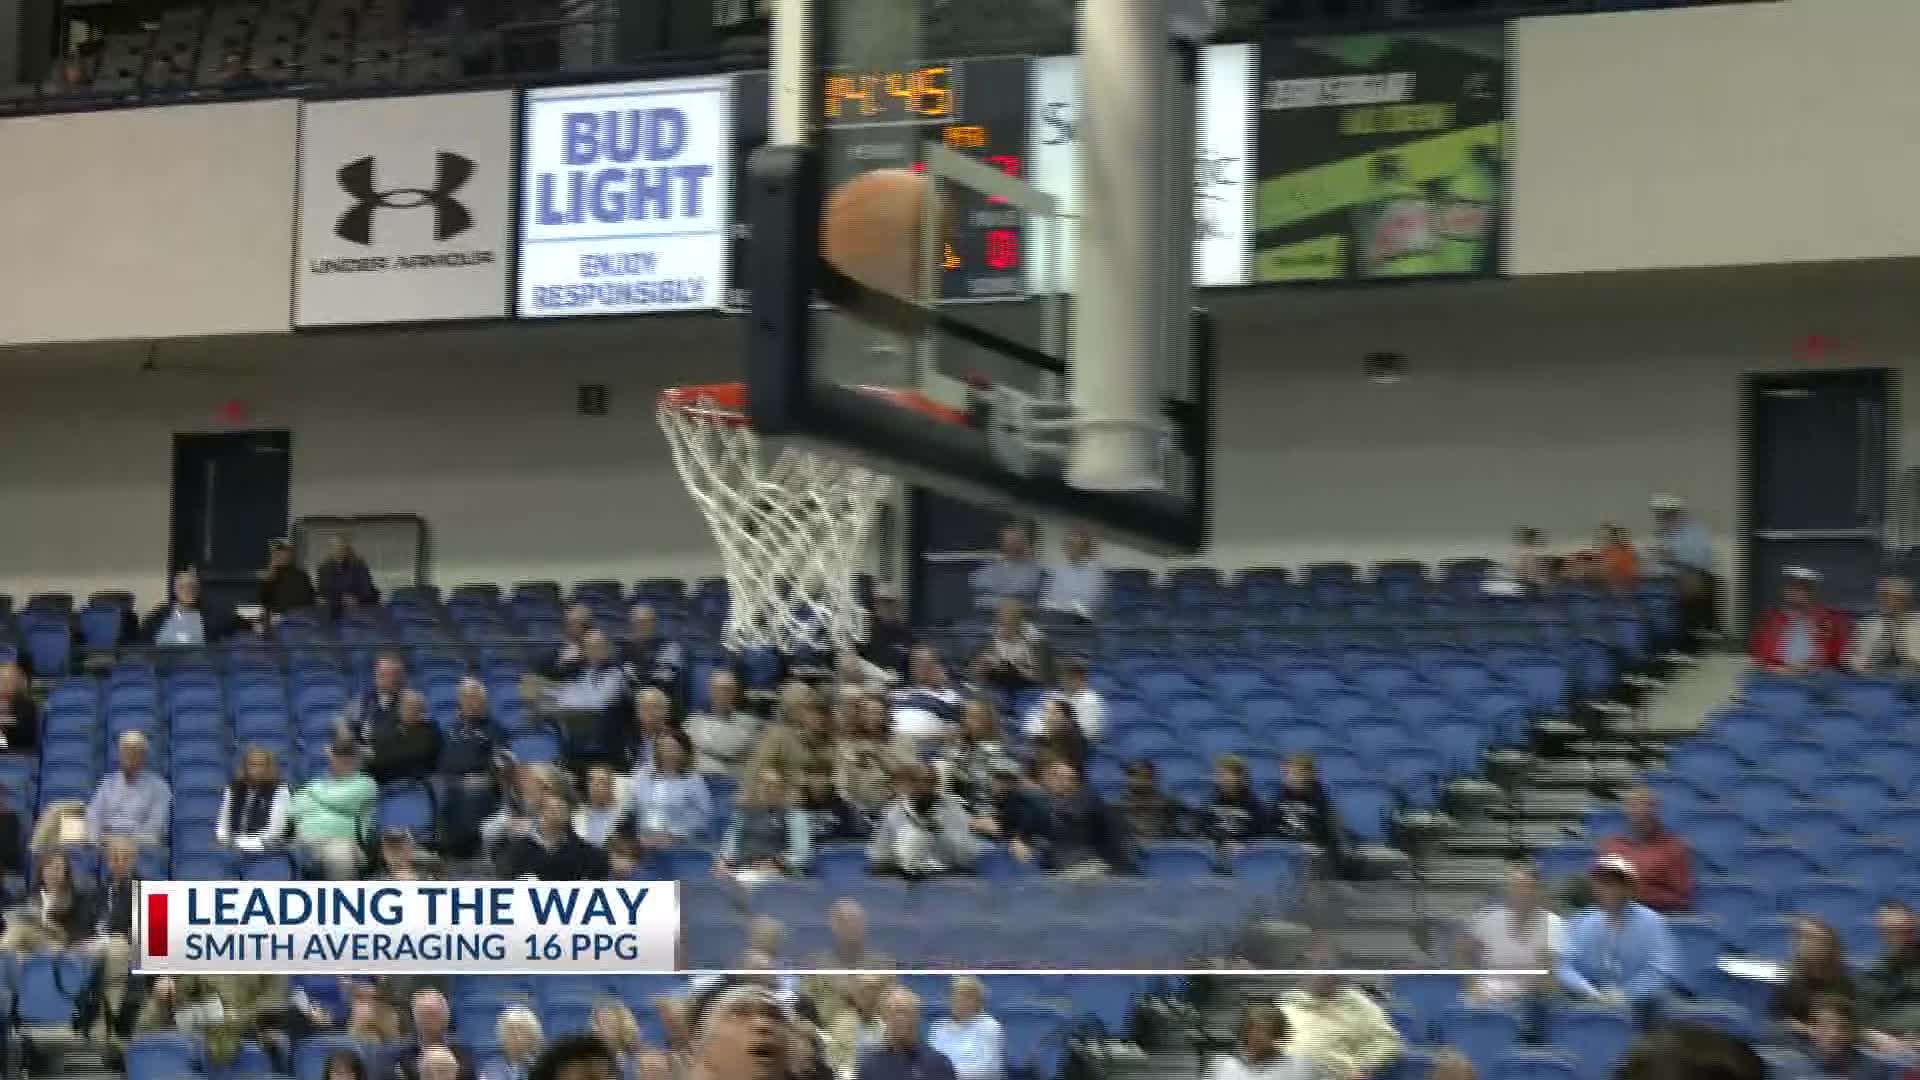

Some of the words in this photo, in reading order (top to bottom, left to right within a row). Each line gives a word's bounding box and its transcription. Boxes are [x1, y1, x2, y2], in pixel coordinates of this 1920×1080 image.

[562, 107, 690, 166] BUD
[536, 164, 713, 226] LIGHT
[309, 254, 388, 274] UNDER
[393, 249, 496, 270] ARMOUR
[578, 251, 658, 278] ENJOY
[531, 276, 705, 308] RESPONSIBLY
